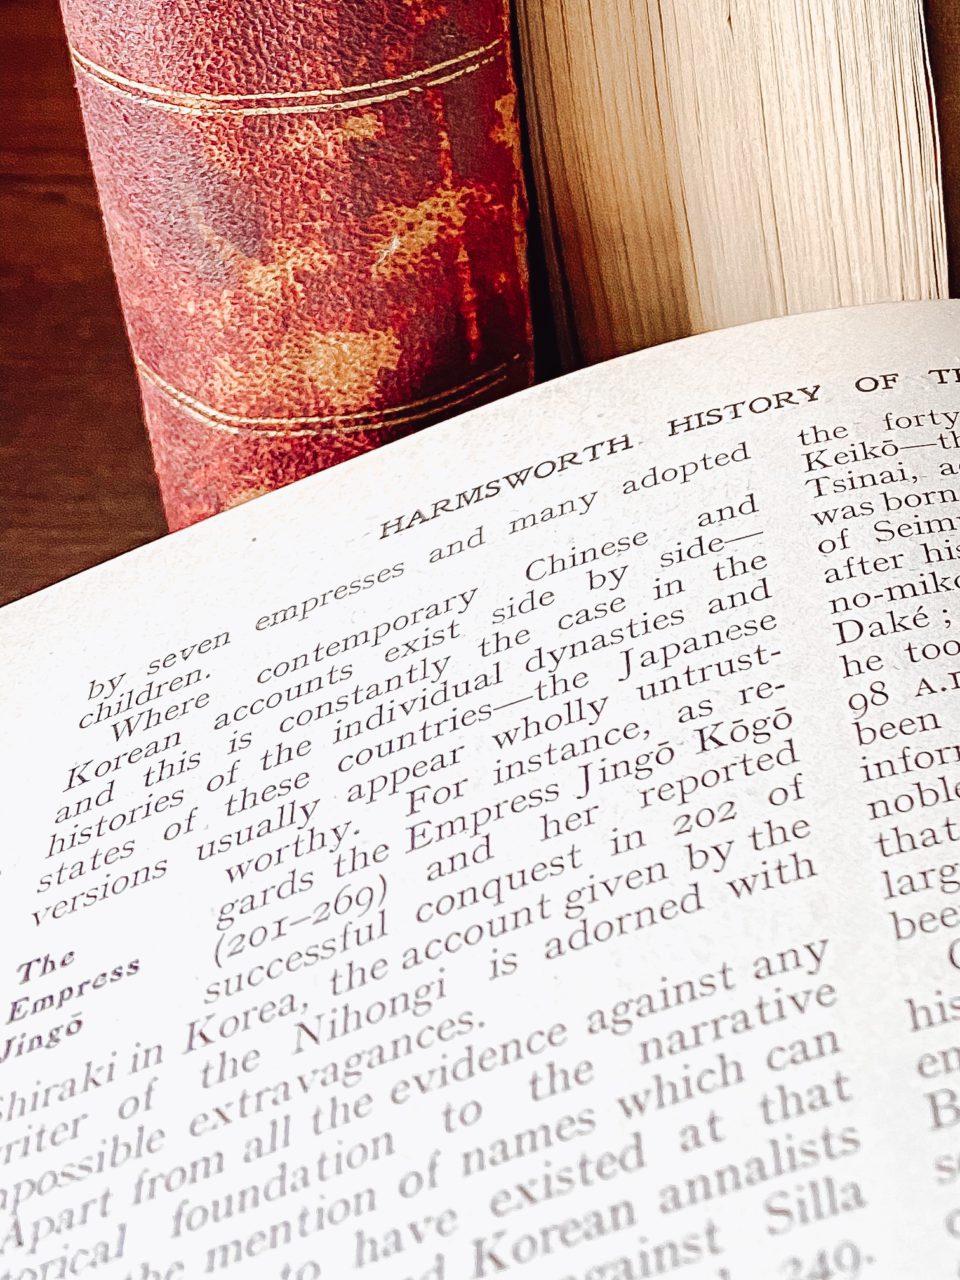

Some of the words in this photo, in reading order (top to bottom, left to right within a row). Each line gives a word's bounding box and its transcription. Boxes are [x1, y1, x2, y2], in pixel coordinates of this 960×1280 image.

[379, 433, 634, 540] HARMSWORTH
[667, 384, 821, 437] HISTORY
[855, 373, 899, 393] OF
[797, 425, 849, 446] the
[804, 463, 918, 499] Tsinai,
[810, 501, 875, 526] was
[879, 489, 960, 512] born
[817, 527, 851, 554] of
[87, 672, 127, 701] by
[147, 632, 231, 676] seven
[255, 562, 404, 631] empresses
[429, 525, 486, 563] and
[508, 491, 598, 535] many
[622, 441, 752, 495] adopted
[110, 693, 210, 742] Where
[257, 587, 478, 684] contemporary
[525, 532, 649, 581] Chinese
[697, 492, 760, 527] and
[824, 553, 904, 584] after
[62, 732, 181, 793] Korean
[213, 664, 353, 730] accounts
[385, 619, 461, 663] exist
[492, 589, 555, 625] side
[585, 565, 629, 591] by
[78, 669, 210, 729] children.
[216, 868, 314, 931] gards
[333, 844, 389, 878] the
[405, 783, 559, 854] Empress
[427, 833, 495, 882] and
[539, 805, 599, 842] her
[639, 737, 800, 809] reported
[16, 951, 75, 985] The
[184, 994, 308, 1054] Korea,
[330, 958, 388, 996] the
[402, 894, 551, 970] account
[564, 862, 669, 920] given
[684, 840, 735, 873] by
[748, 819, 811, 851] the
[6, 959, 140, 1025] Empress
[391, 1022, 566, 1104] evidence
[587, 962, 735, 1034] against
[753, 939, 829, 980] any
